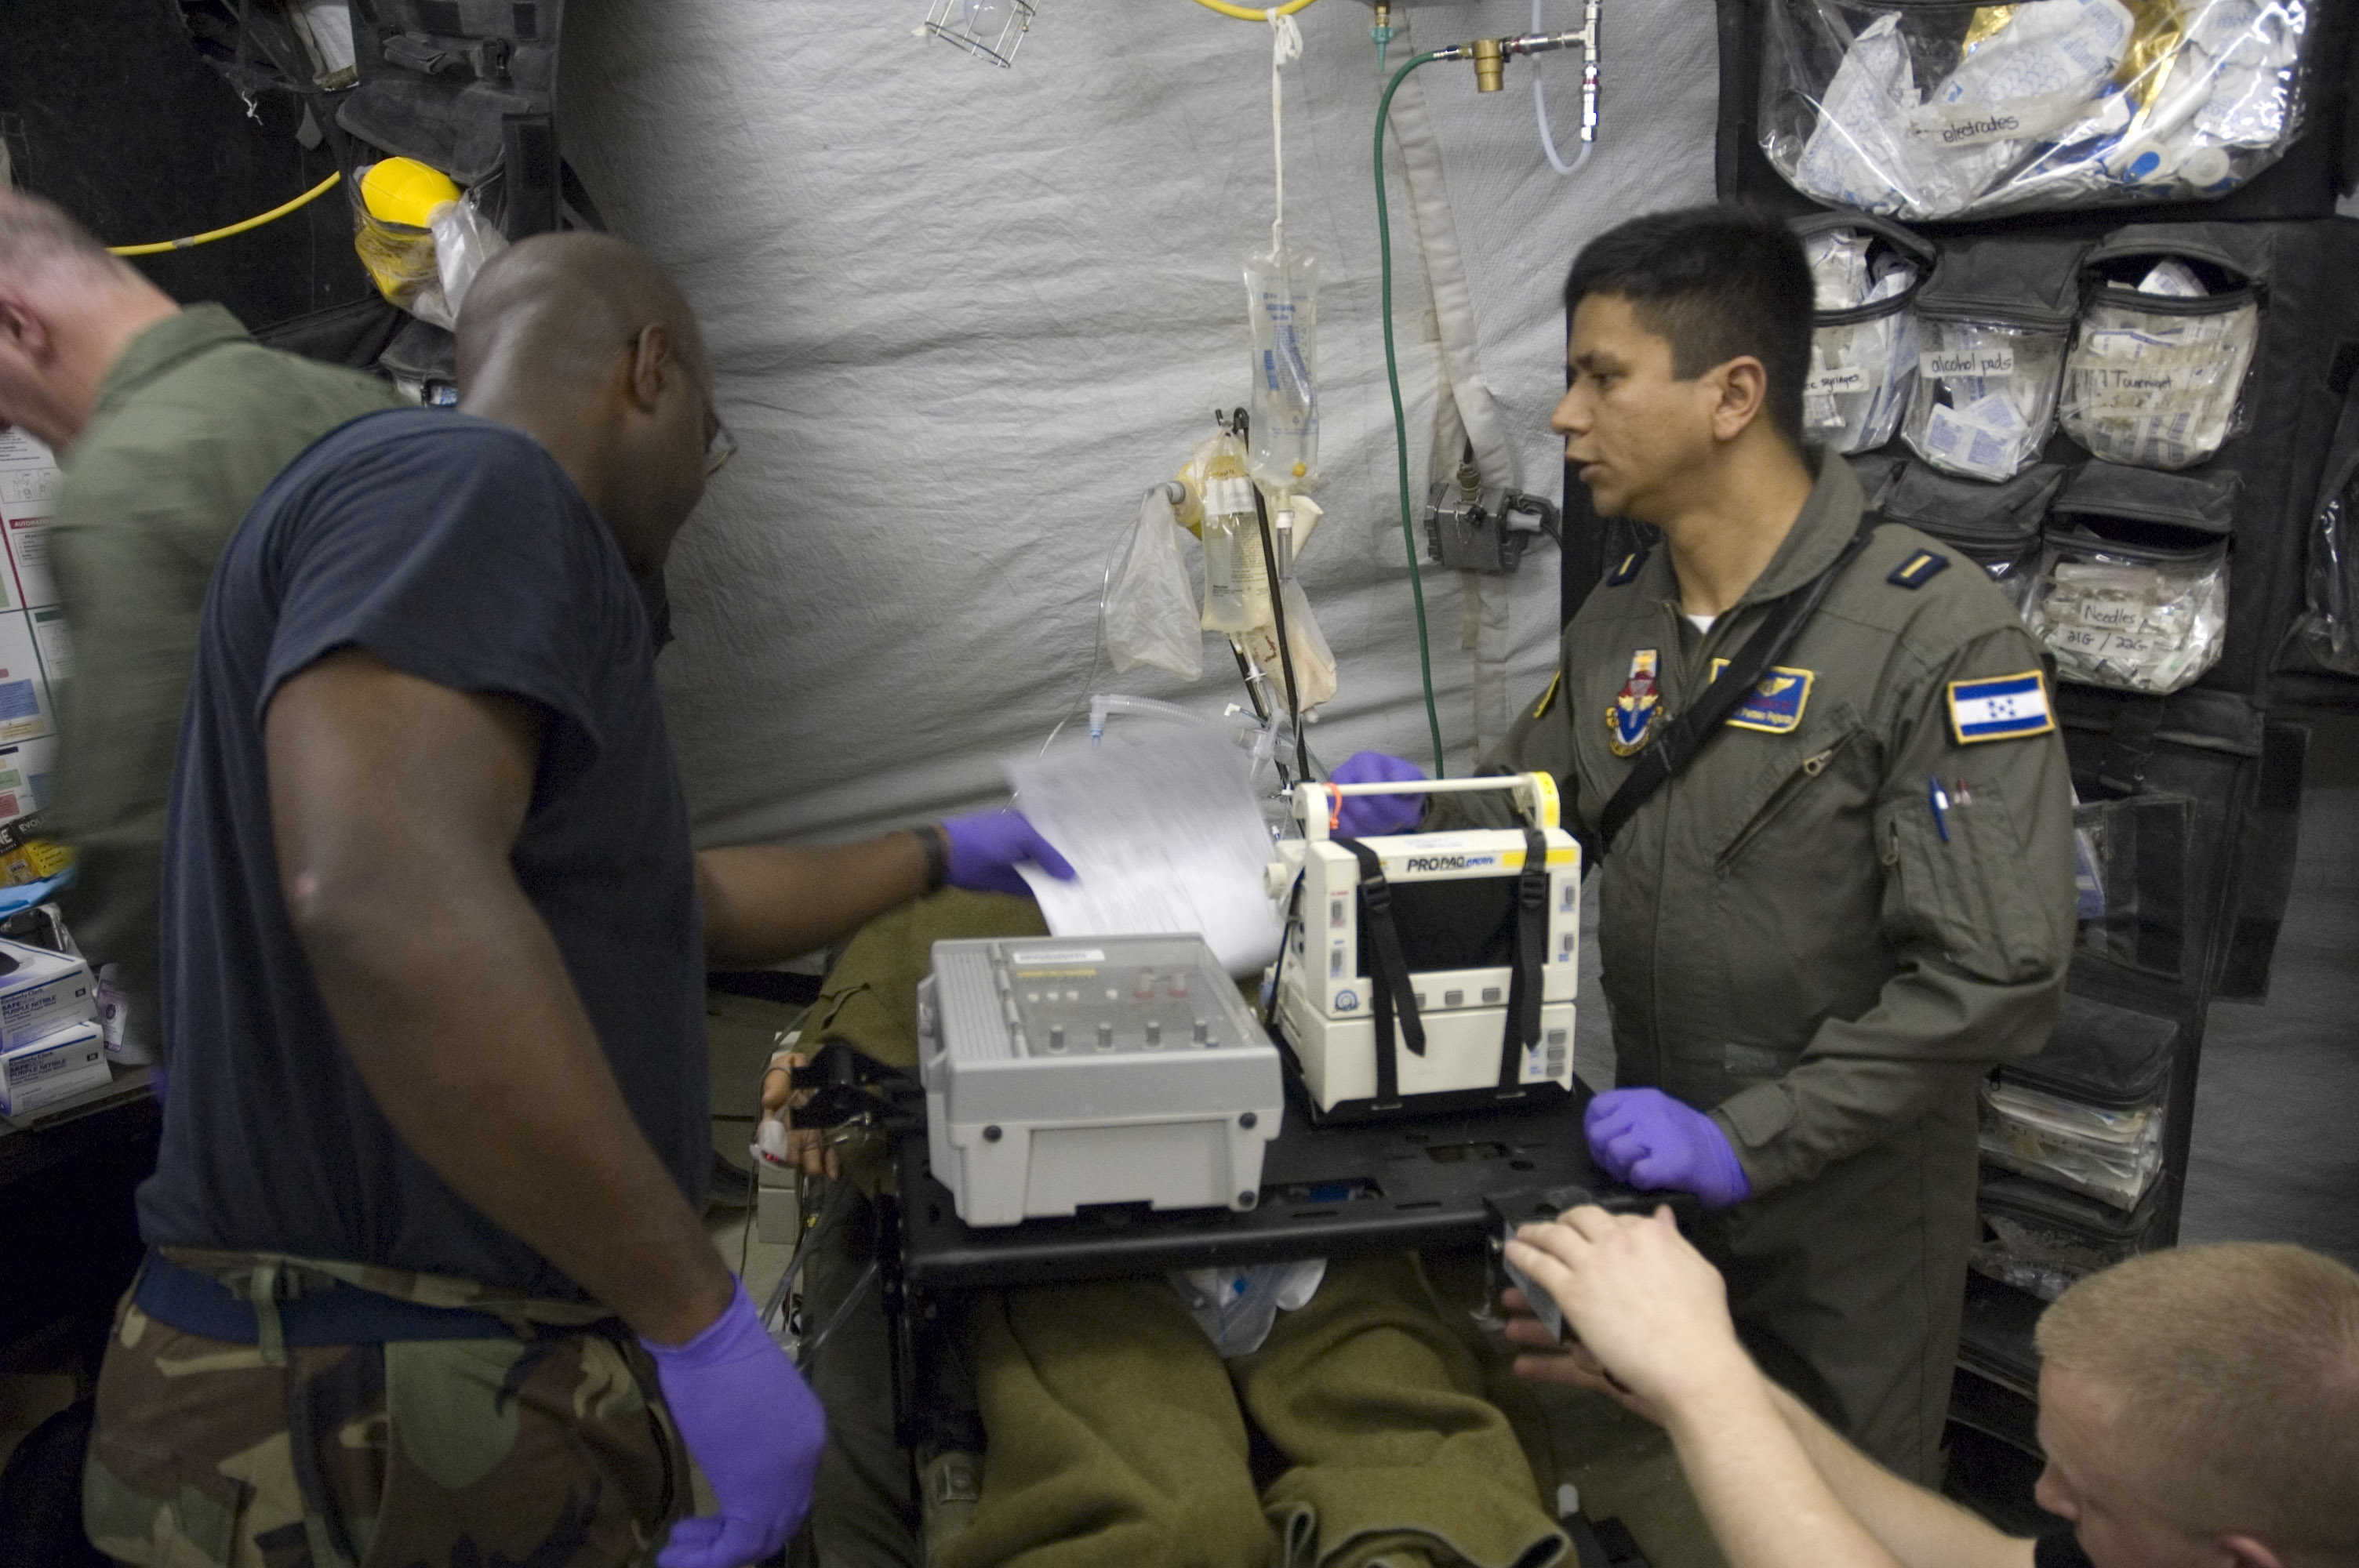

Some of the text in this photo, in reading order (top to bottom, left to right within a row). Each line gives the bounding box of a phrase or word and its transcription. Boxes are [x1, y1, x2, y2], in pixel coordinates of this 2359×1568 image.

[1943, 116, 2019, 143] electrodes
[1932, 353, 2012, 376] alcohol pads
[2085, 605, 2135, 626] Needles
[1407, 856, 1465, 872] PROPAQ
